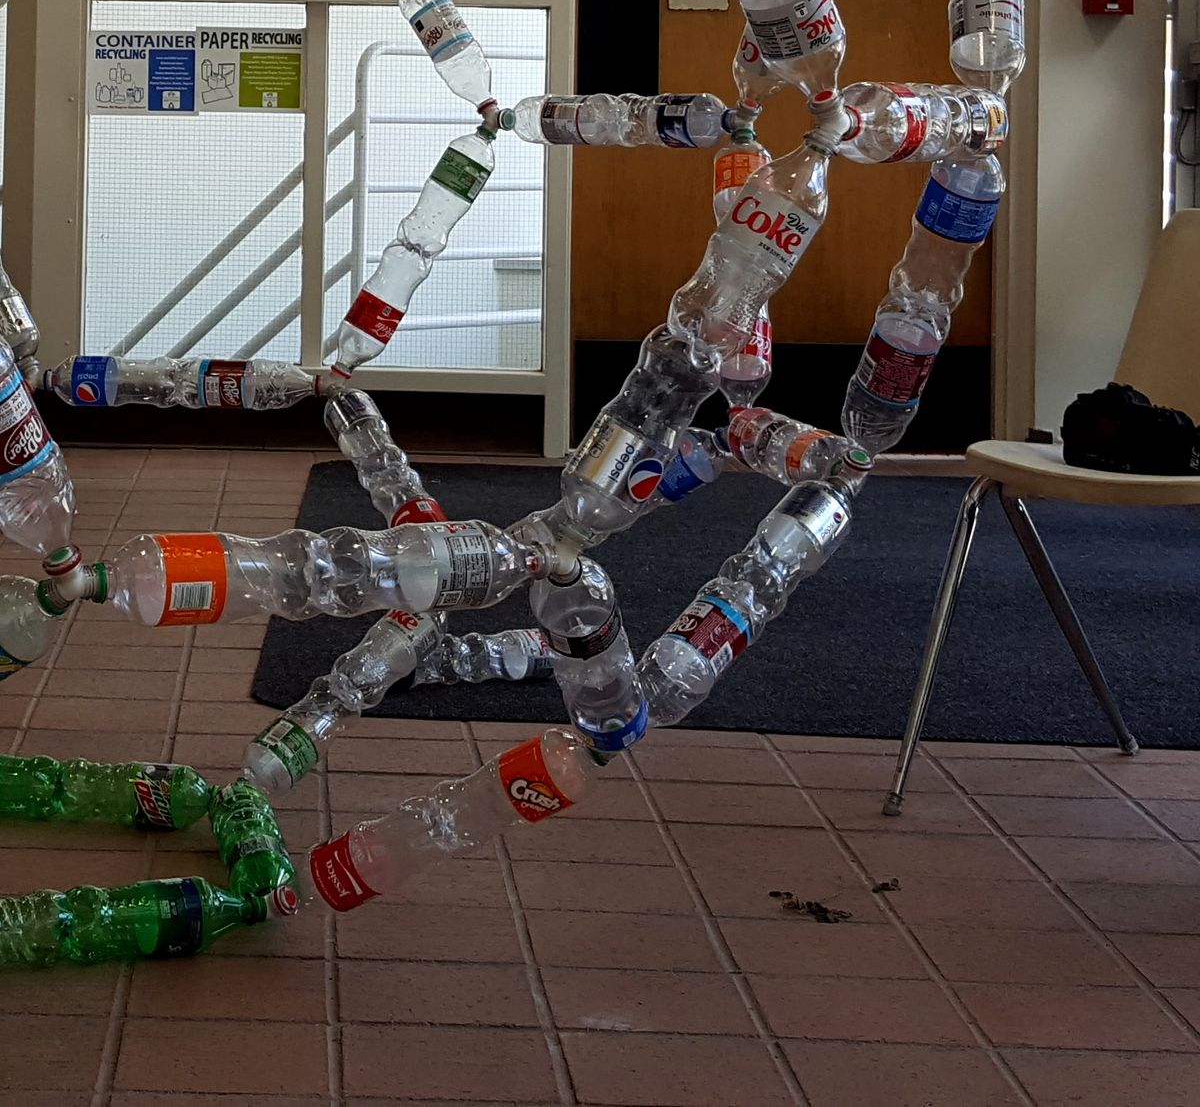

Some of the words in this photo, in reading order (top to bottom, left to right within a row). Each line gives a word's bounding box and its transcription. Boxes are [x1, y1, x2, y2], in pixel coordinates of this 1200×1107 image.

[95, 34, 195, 48] CONTAINER
[95, 48, 146, 60] RECYCLING
[201, 32, 249, 49] PAPER
[252, 33, 302, 45] RECYCLING
[731, 196, 802, 255] Coke
[786, 213, 809, 235] Diet
[9, 415, 44, 461] Pepper
[23, 439, 39, 458] Dr
[608, 442, 635, 483] pepsi
[511, 779, 560, 811] Crush
[326, 859, 351, 897] Jessica
